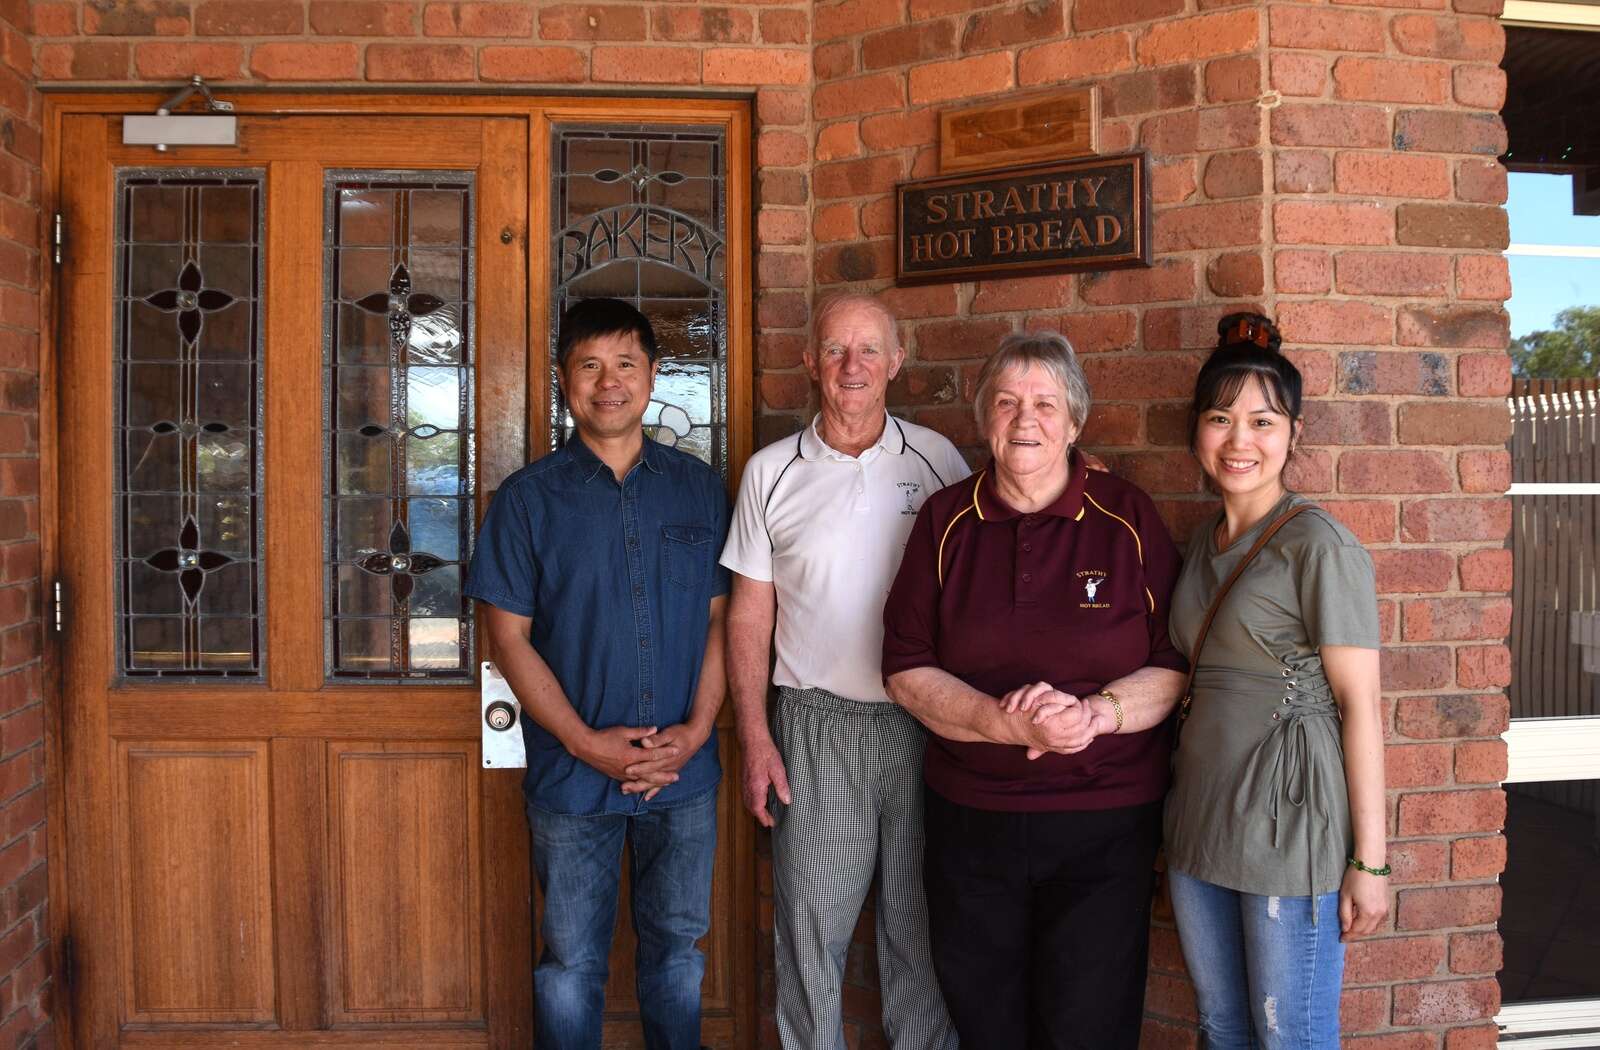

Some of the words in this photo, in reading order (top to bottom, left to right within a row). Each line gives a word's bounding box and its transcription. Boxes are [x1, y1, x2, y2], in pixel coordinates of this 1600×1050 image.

[926, 176, 1107, 225] STRATHY
[557, 207, 722, 288] BAKERY
[911, 228, 976, 262] HOT
[992, 214, 1122, 256] BREAD
